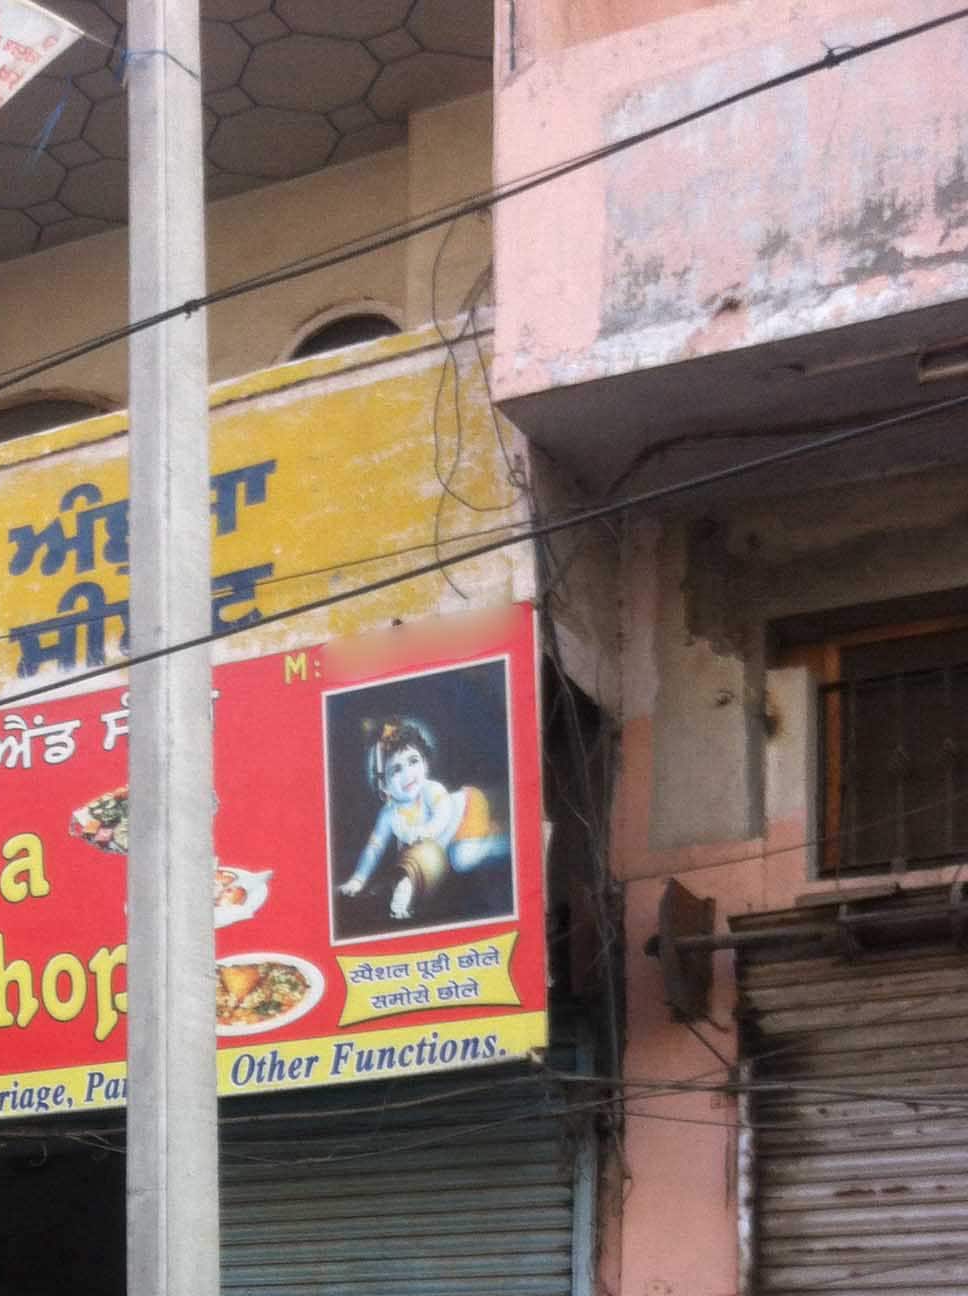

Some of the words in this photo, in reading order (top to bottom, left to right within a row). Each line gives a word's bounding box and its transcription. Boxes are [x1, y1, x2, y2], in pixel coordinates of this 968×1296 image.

[457, 946, 500, 968] छोले
[371, 984, 430, 1009] समोसे
[437, 978, 479, 1001] छोले
[230, 1049, 319, 1087] Other
[329, 1031, 507, 1077] Functions.
